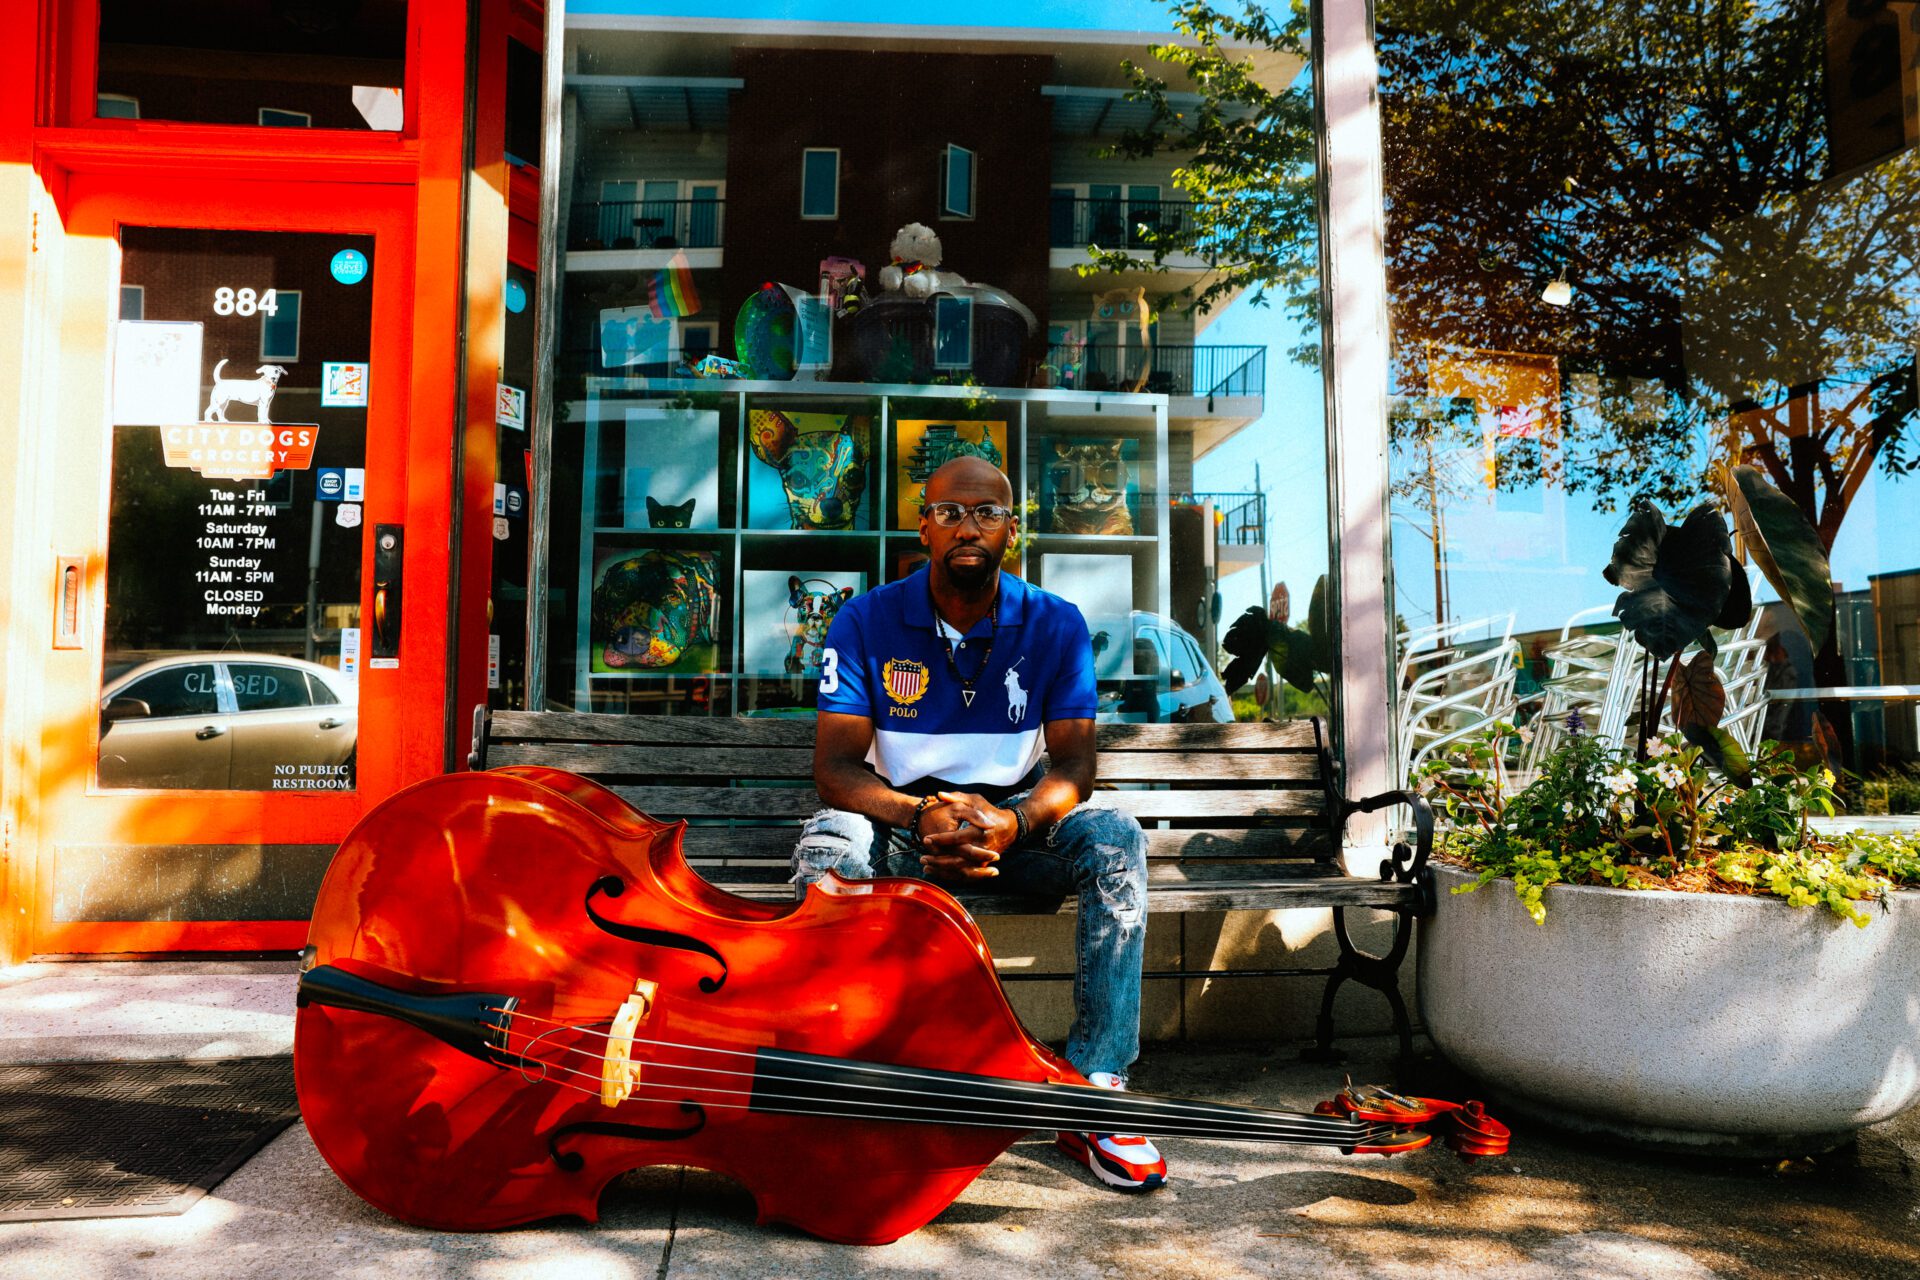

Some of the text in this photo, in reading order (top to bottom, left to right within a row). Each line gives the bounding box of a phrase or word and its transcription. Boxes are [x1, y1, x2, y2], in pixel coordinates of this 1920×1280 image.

[213, 287, 278, 317] 884
[167, 428, 310, 447] CITY DOGS
[190, 450, 288, 463] GROCERY
[210, 489, 235, 501] Tue
[247, 490, 265, 501] Fri
[198, 504, 235, 516] 11AM
[206, 522, 267, 537] Saturday
[196, 537, 234, 549] 10AM
[209, 556, 261, 570] Sunday
[195, 571, 232, 583] 11AM
[245, 571, 274, 583] 5PM
[204, 590, 264, 602] CLOSED
[206, 603, 261, 618] Monday
[819, 648, 838, 693] 3
[889, 706, 918, 718] POLO
[274, 765, 349, 775] NO PUBLIC
[272, 779, 350, 789] RESTROOM
